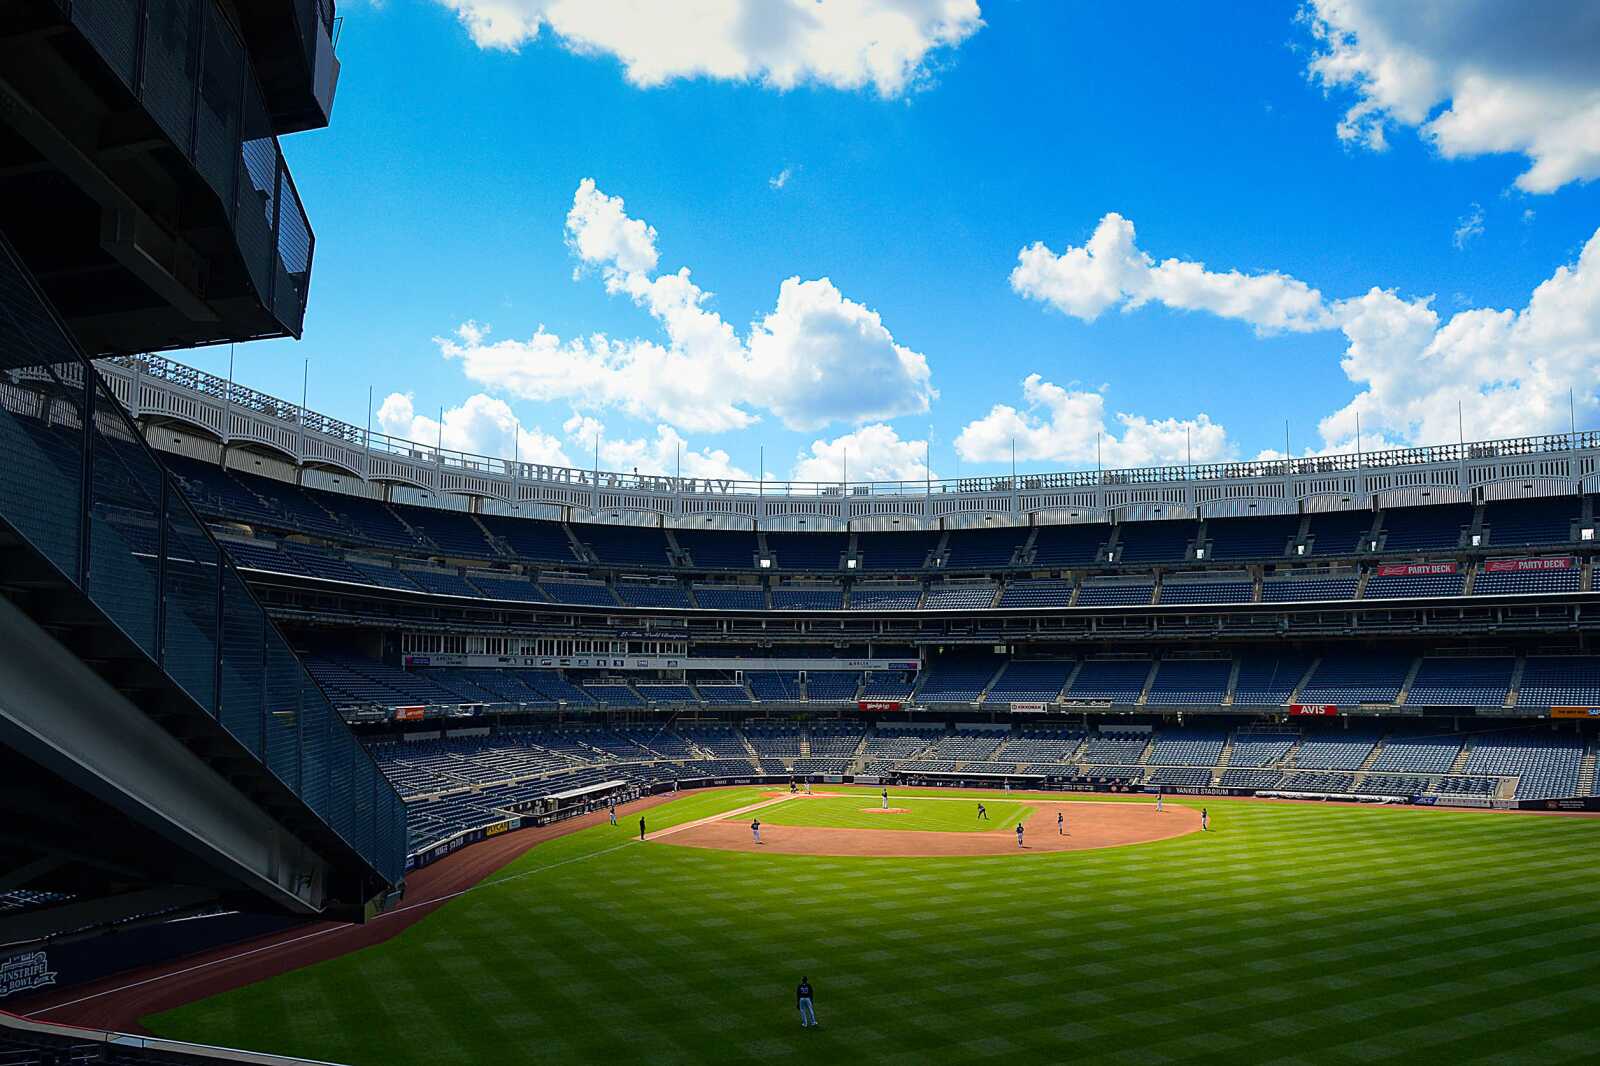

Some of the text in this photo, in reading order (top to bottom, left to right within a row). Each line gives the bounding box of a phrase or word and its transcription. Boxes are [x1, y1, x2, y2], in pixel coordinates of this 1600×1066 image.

[1408, 565, 1431, 574] PARTY
[1431, 564, 1451, 573] DECK
[1519, 561, 1543, 569] PARTY
[1544, 560, 1565, 568] DECK
[1300, 705, 1326, 715] AVIS
[1175, 787, 1229, 796] YANKEE STADIUM
[9, 977, 33, 990] BOWL
